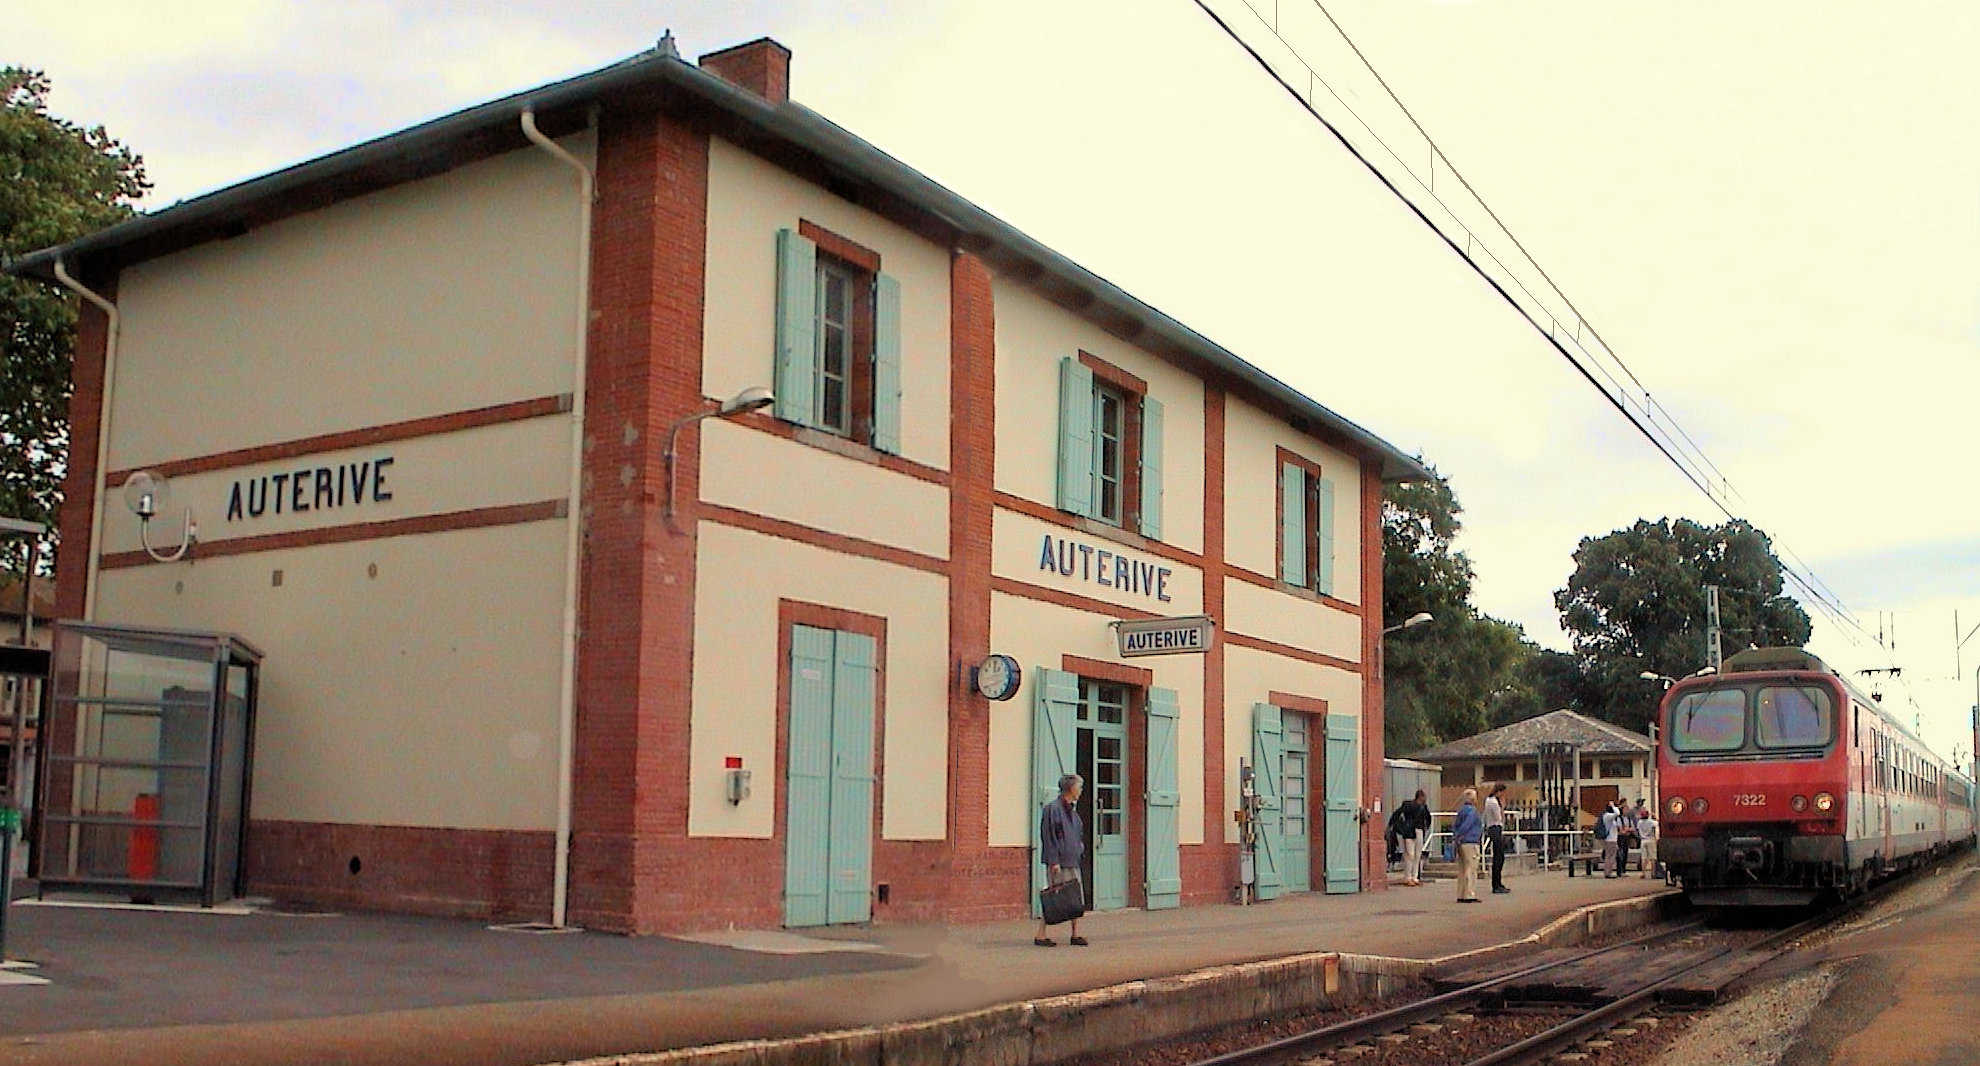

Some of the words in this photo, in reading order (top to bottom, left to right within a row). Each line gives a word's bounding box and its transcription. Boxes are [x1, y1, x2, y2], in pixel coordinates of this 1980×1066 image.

[227, 456, 394, 522] AUTERIVE
[1040, 534, 1172, 602] AUTERIVE
[1127, 629, 1198, 650] AUTERIVE
[1732, 794, 1767, 807] 7322
